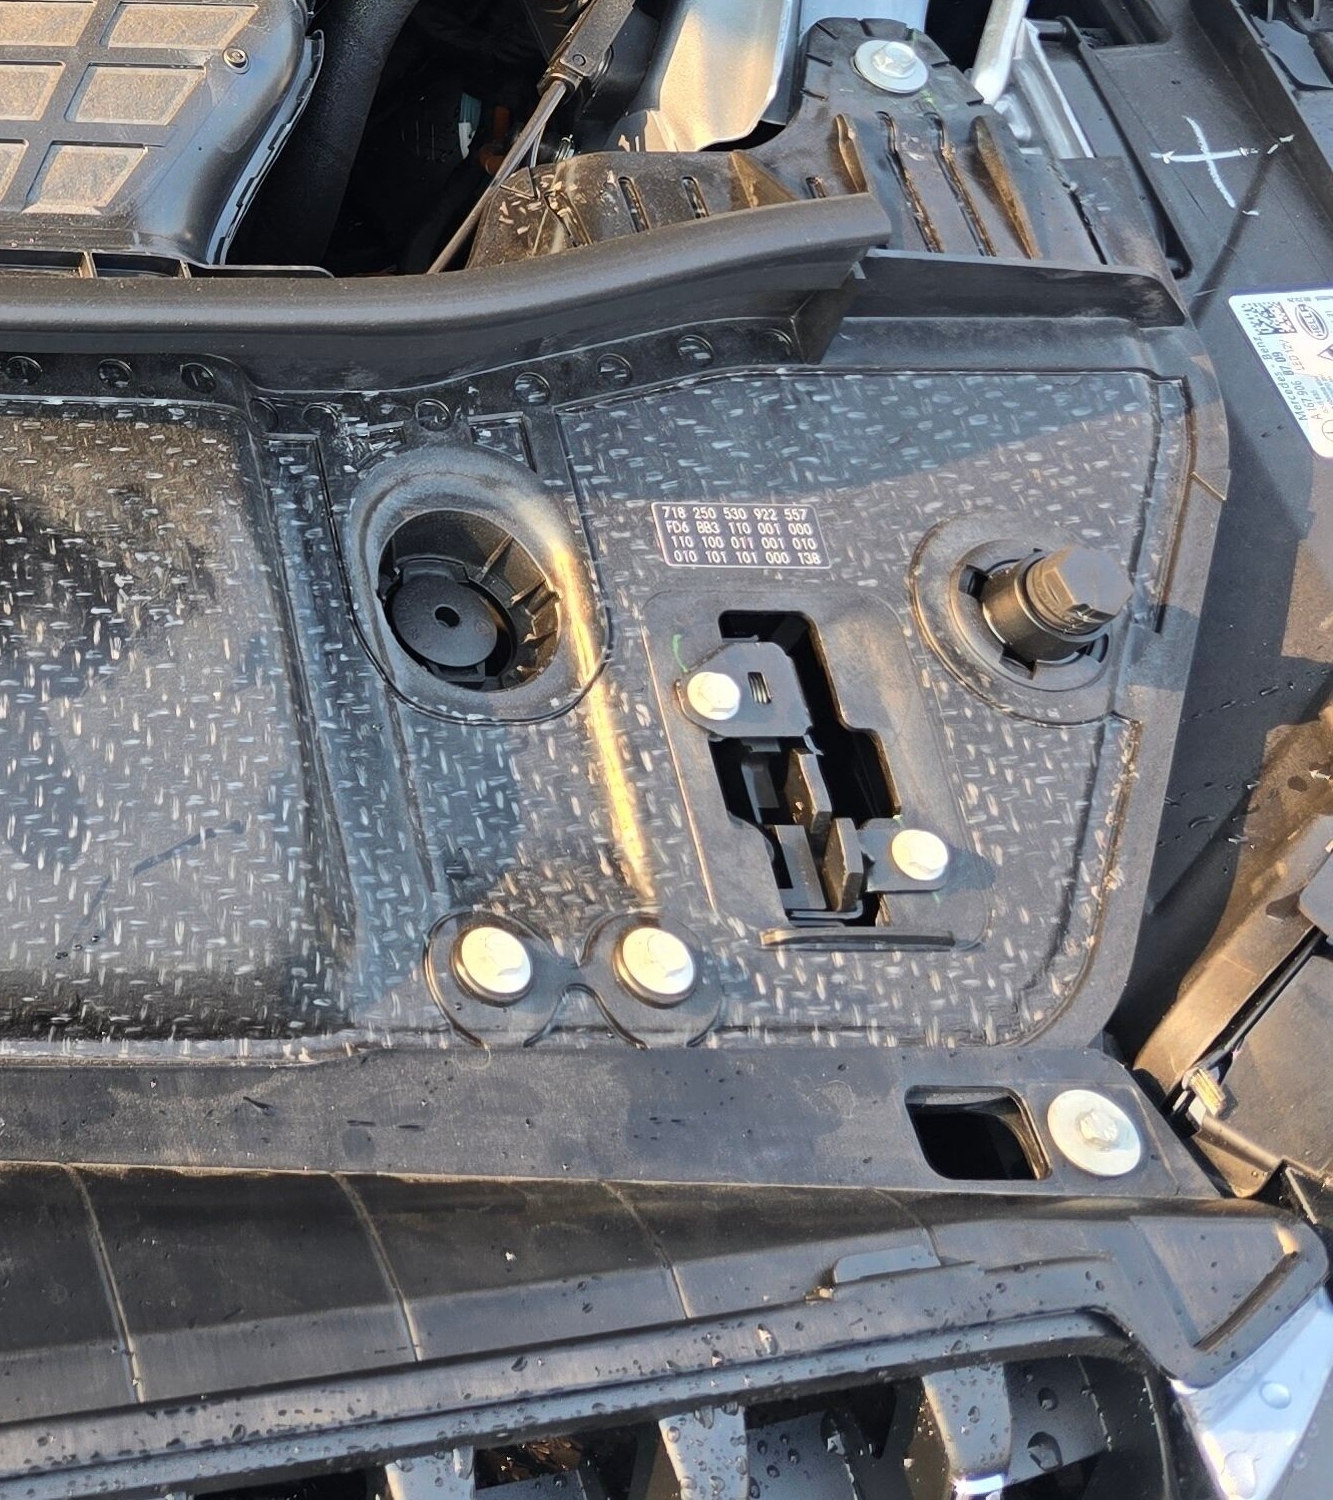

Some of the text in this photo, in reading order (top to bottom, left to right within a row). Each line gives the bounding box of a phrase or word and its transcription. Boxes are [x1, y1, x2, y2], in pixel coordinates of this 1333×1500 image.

[1298, 303, 1324, 336] HELLA
[1252, 336, 1273, 360] Benz
[1272, 351, 1287, 362] 09
[1289, 355, 1305, 371] LED
[1291, 380, 1309, 395] 906
[1274, 372, 1309, 421] Mercedes
[1301, 397, 1317, 411] 167
[662, 506, 808, 521] 718 250 530 922 557
[665, 520, 690, 533] FD6
[728, 522, 751, 534] 110
[758, 522, 782, 535] 001
[788, 523, 813, 535] 000
[671, 536, 817, 550] 110 100 011 001 010
[673, 550, 821, 565] 010 101 101 000 138
